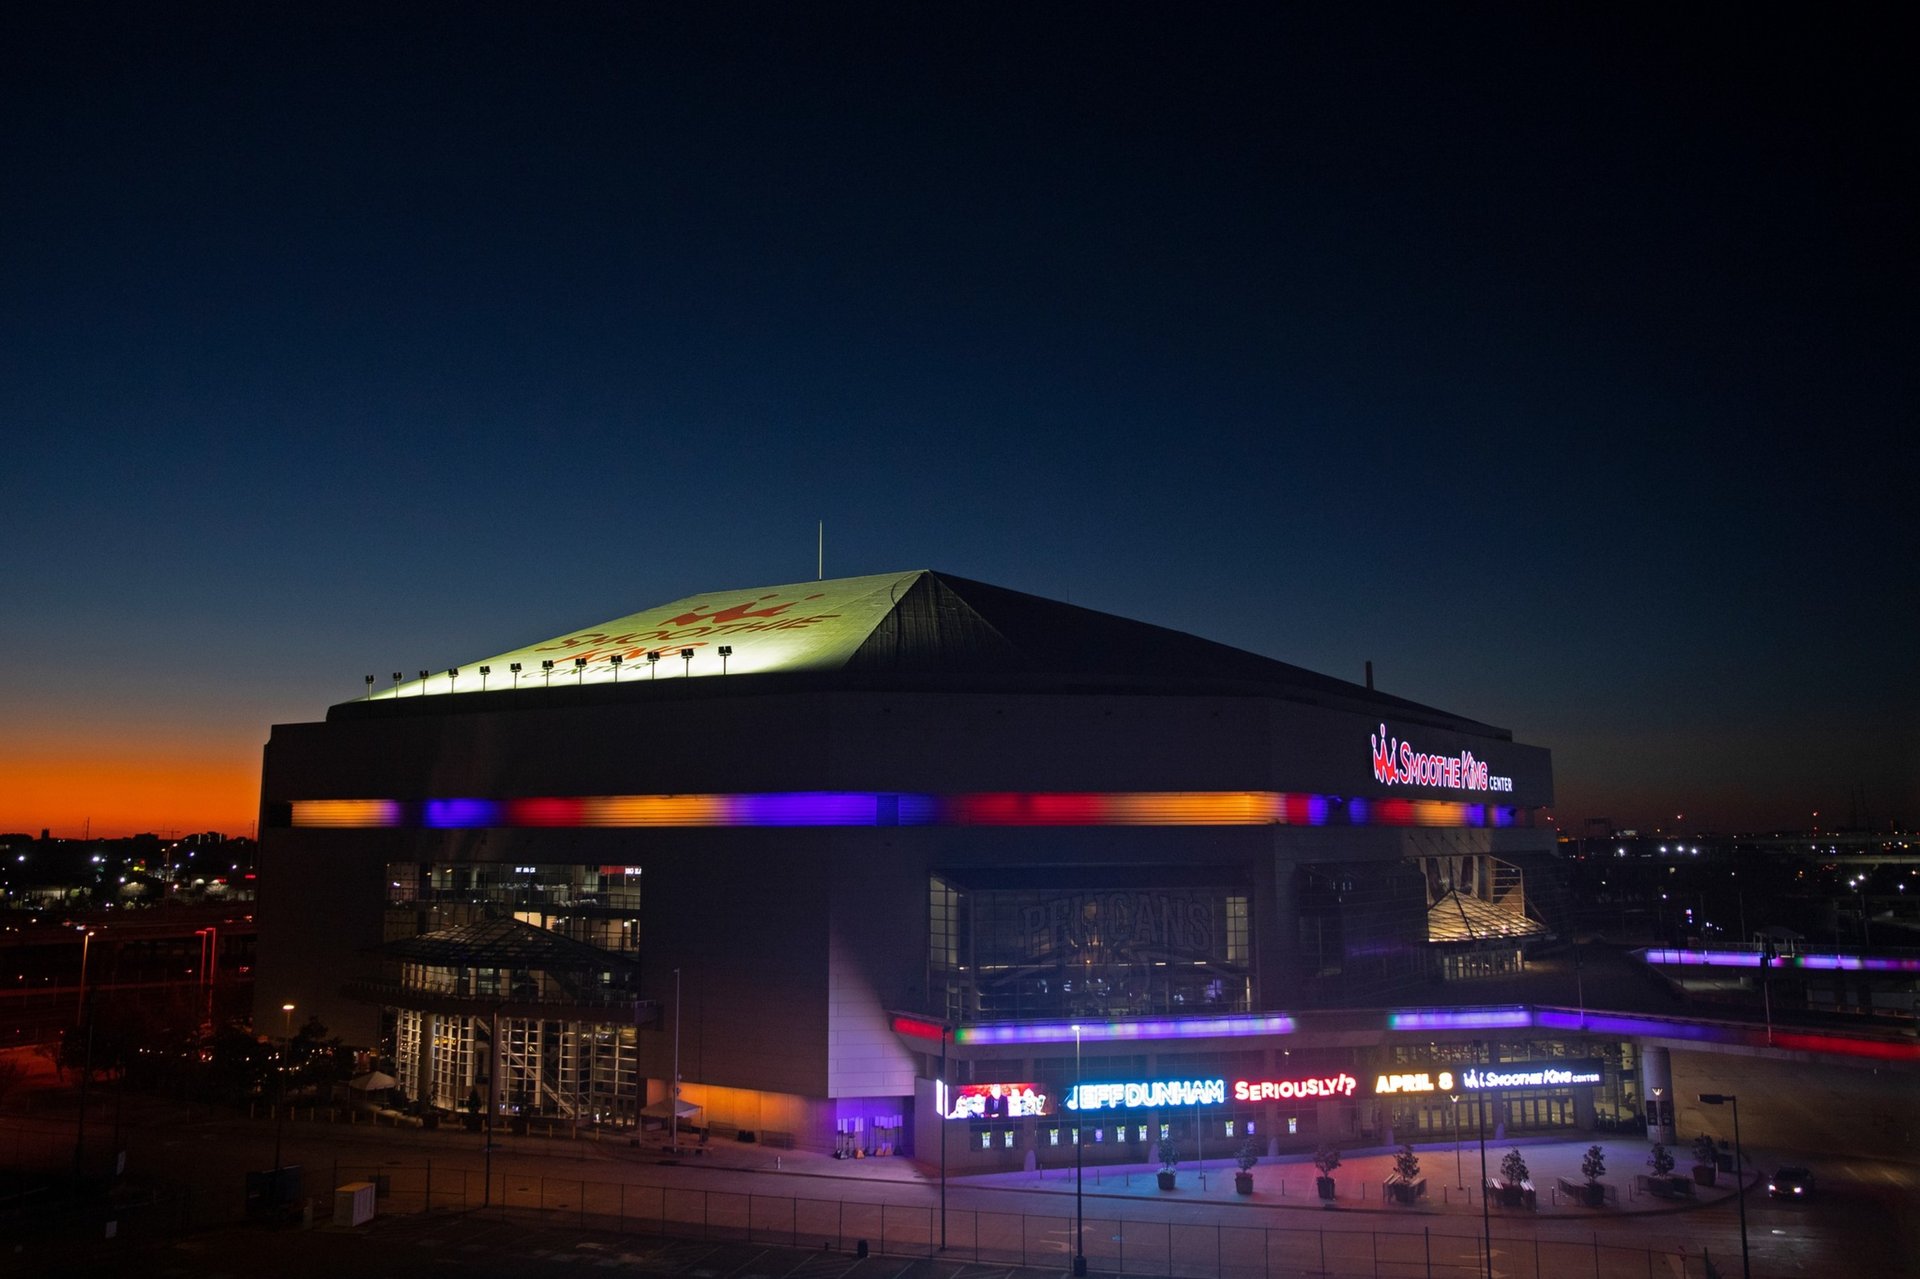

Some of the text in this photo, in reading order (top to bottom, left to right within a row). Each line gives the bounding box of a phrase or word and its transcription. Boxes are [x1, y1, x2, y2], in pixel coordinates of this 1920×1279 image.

[1489, 776, 1513, 792] CENTER
[1021, 892, 1212, 955] PELICANS
[1066, 1083, 1125, 1110] JEFF
[1125, 1079, 1224, 1108] DUNHAM
[1375, 1073, 1434, 1093] APRIL
[1438, 1072, 1453, 1090] 8
